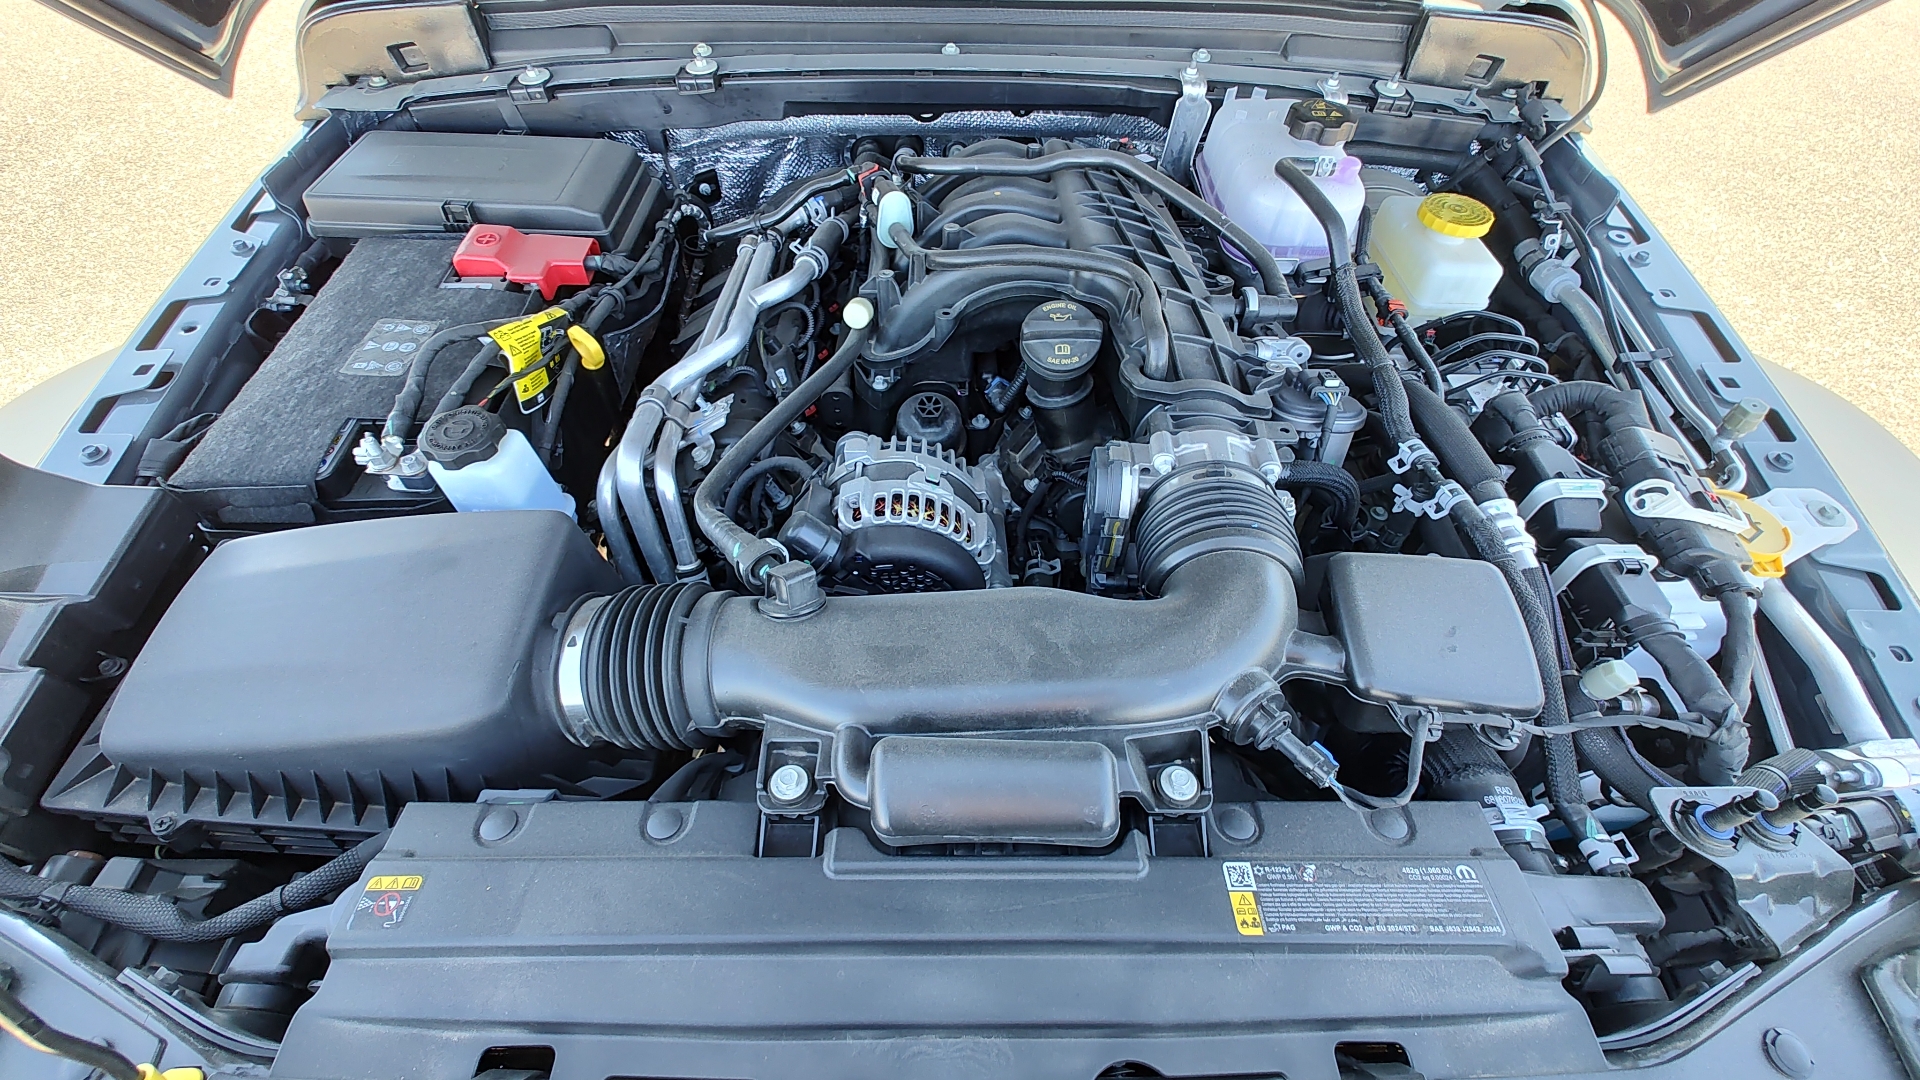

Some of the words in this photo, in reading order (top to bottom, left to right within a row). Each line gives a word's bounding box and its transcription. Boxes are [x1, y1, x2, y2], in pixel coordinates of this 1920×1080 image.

[1042, 303, 1066, 312] ENGINE
[1067, 303, 1077, 311] OIL
[1047, 356, 1060, 364] SAE
[1061, 356, 1079, 365] 0W-20
[1494, 786, 1513, 795] RAD
[1264, 866, 1292, 874] R-1234yf
[1402, 866, 1420, 875] 482g
